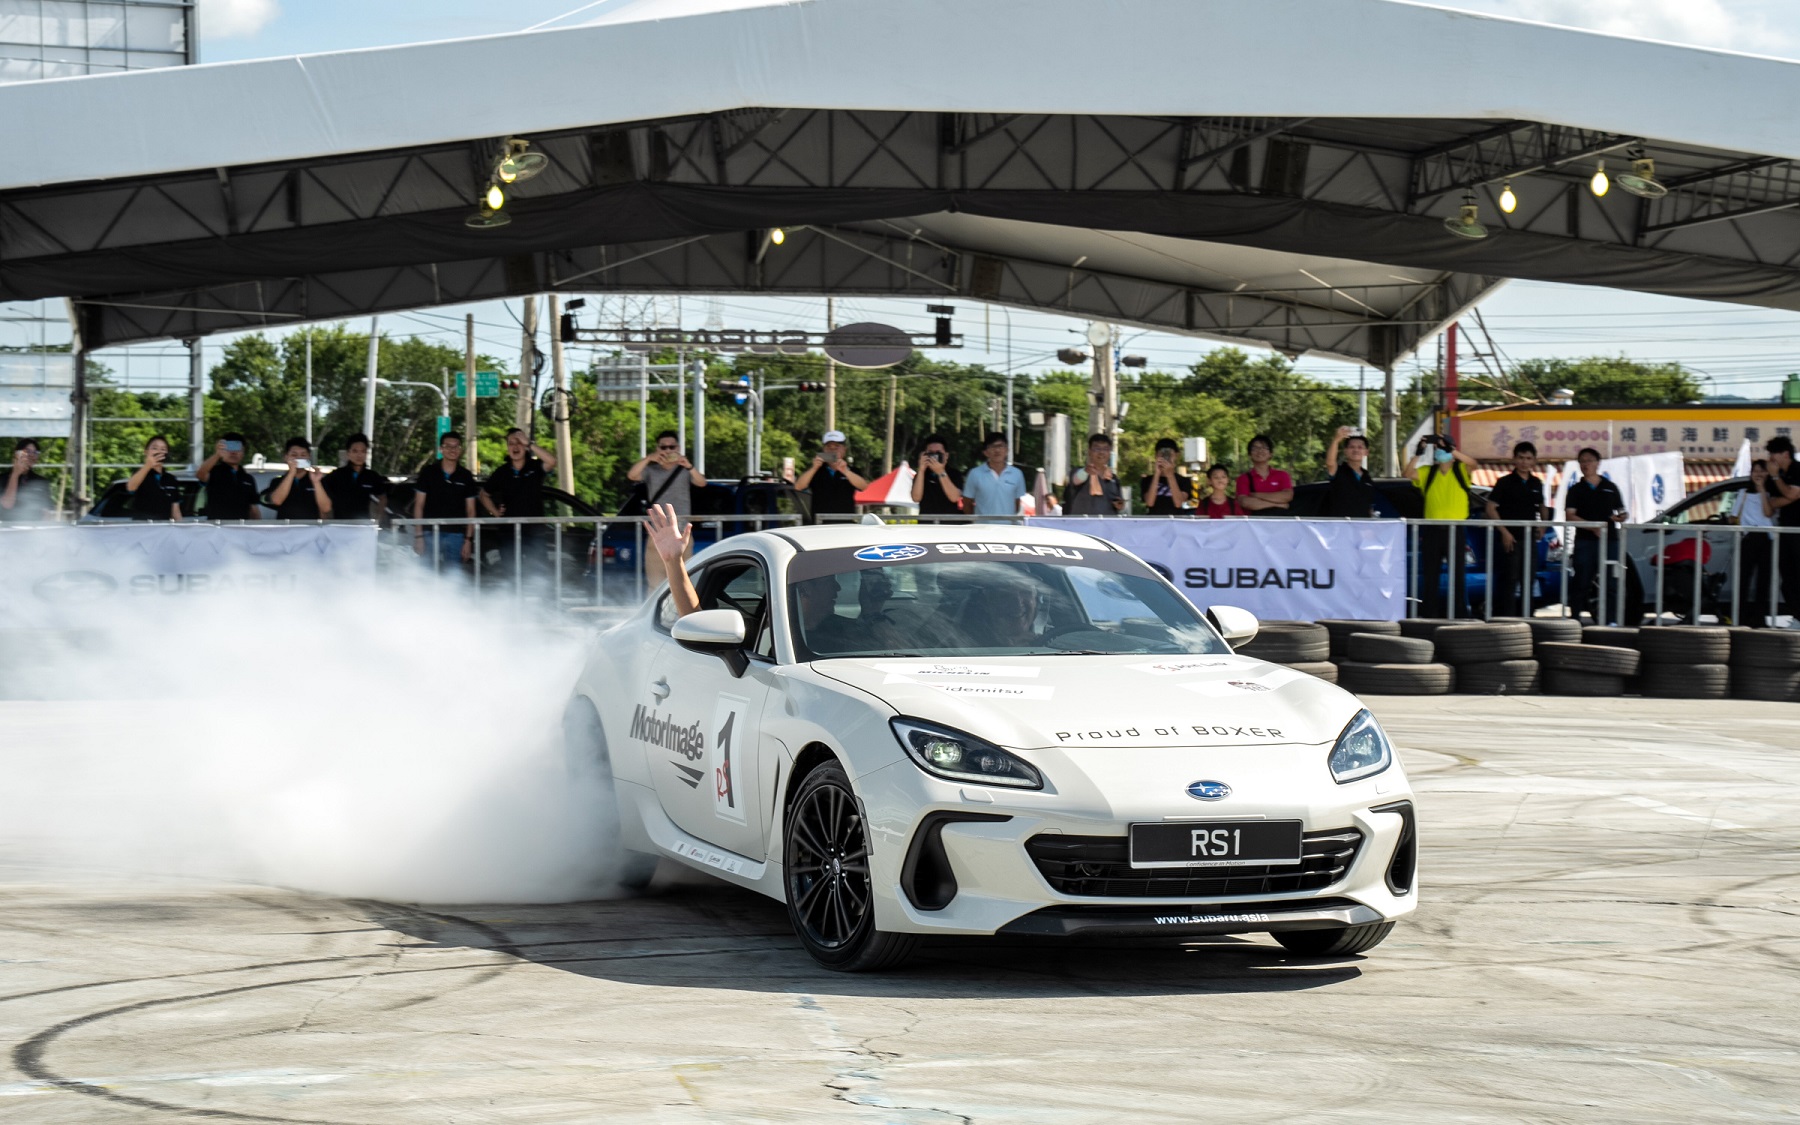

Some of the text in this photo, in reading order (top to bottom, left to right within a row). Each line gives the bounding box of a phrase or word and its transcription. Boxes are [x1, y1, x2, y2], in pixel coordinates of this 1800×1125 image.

[936, 543, 1084, 560] SUBARU
[1184, 567, 1336, 589] SUBARU
[945, 686, 1024, 695] idemitsu
[1055, 725, 1285, 742] Proud of BOXER
[717, 711, 736, 809] 1
[1190, 828, 1242, 857] RS1
[1153, 912, 1270, 925] www.subaru.asia
